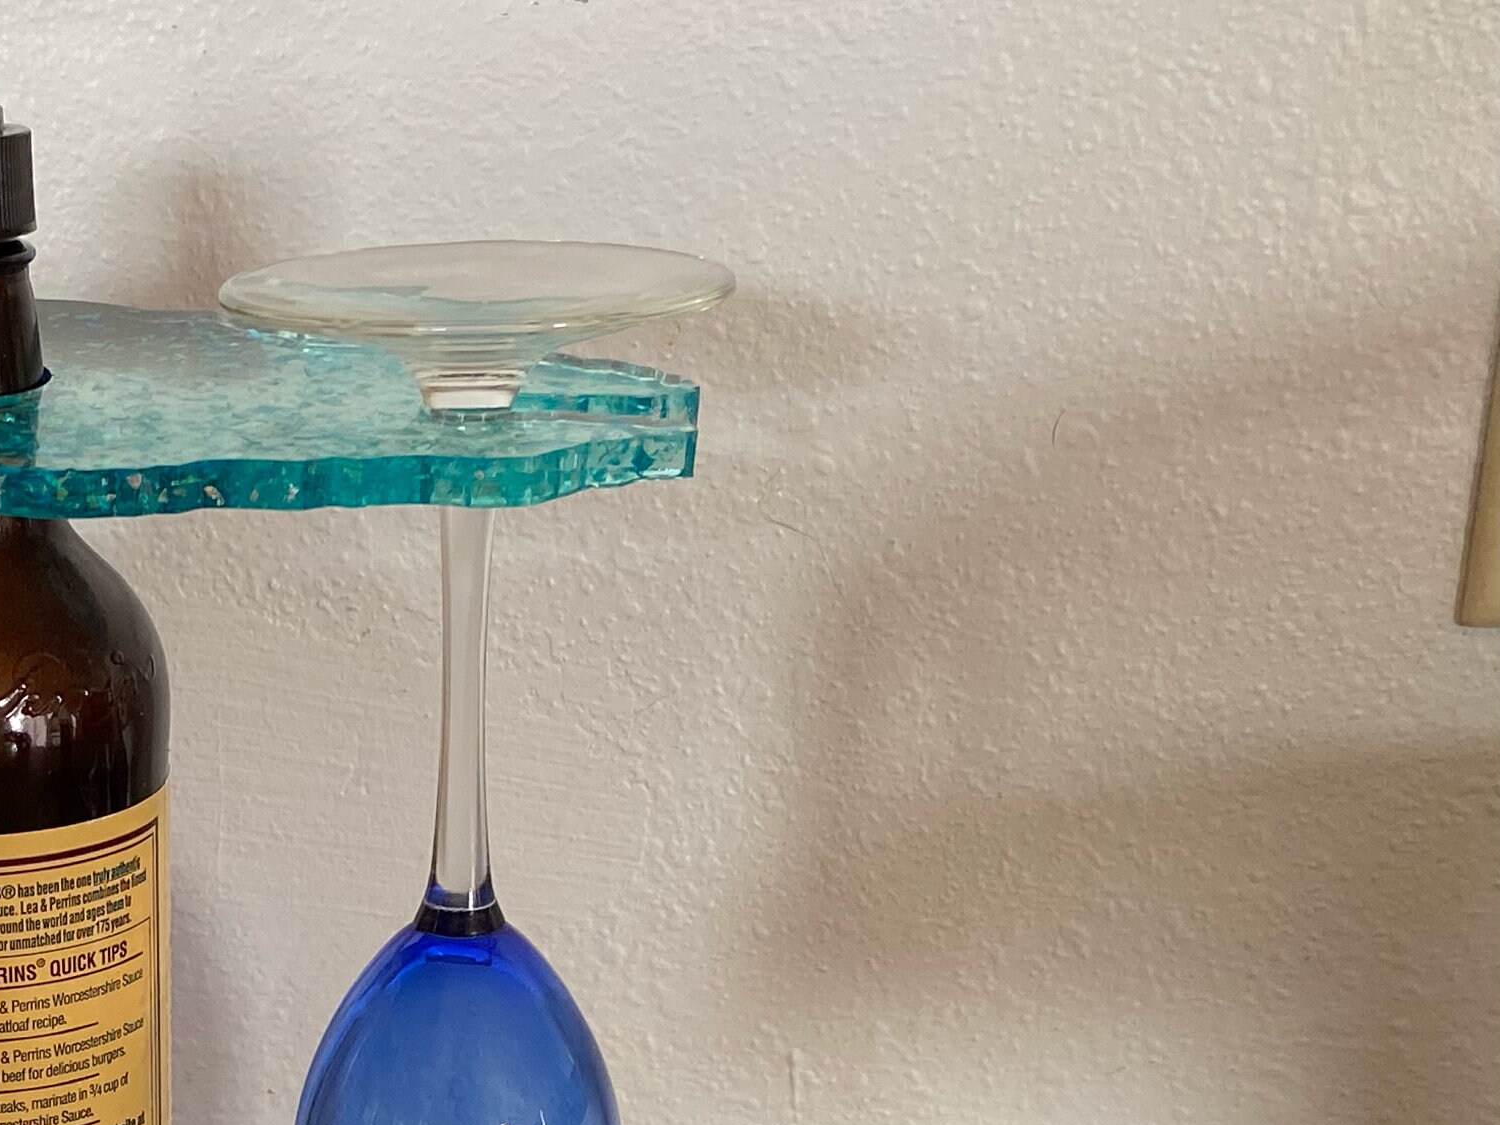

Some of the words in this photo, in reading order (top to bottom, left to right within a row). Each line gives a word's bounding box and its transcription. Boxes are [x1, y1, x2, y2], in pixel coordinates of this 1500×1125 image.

[17, 883, 35, 898] has
[36, 881, 59, 895] been
[61, 876, 75, 891] the
[76, 875, 91, 888] one
[93, 867, 111, 886] truly
[20, 901, 38, 915] Lea
[40, 898, 47, 912] &
[49, 893, 81, 911] Perrins
[82, 883, 119, 904] combines
[120, 878, 131, 892] the
[25, 917, 41, 931] the
[42, 911, 68, 929] world
[69, 908, 85, 924] and
[86, 905, 105, 922] ages
[106, 898, 124, 915] them
[125, 894, 131, 907] to
[10, 930, 61, 948] unmatched
[62, 927, 75, 941] for
[76, 925, 94, 939] over
[96, 918, 110, 935] 175
[50, 951, 97, 977] QUICK
[99, 940, 128, 965] TIPS
[0, 1000, 8, 1014] &
[11, 996, 51, 1013] Perrins
[52, 977, 121, 1007] Worcestershire
[122, 968, 143, 987] Sauce
[32, 1014, 68, 1030] recipe.
[0, 1050, 10, 1064] &
[13, 1047, 52, 1063] Perrins
[53, 1027, 122, 1057] Worcestershire
[123, 1017, 144, 1036] Sauce
[1, 1067, 27, 1083] beef
[28, 1067, 44, 1080] for
[46, 1059, 91, 1078] delicious
[31, 1091, 77, 1110] marinate
[79, 1088, 88, 1101] in
[103, 1078, 119, 1094] cup
[120, 1071, 129, 1086] of
[61, 1107, 94, 1123] Sauce.
[137, 1110, 145, 1125] at
